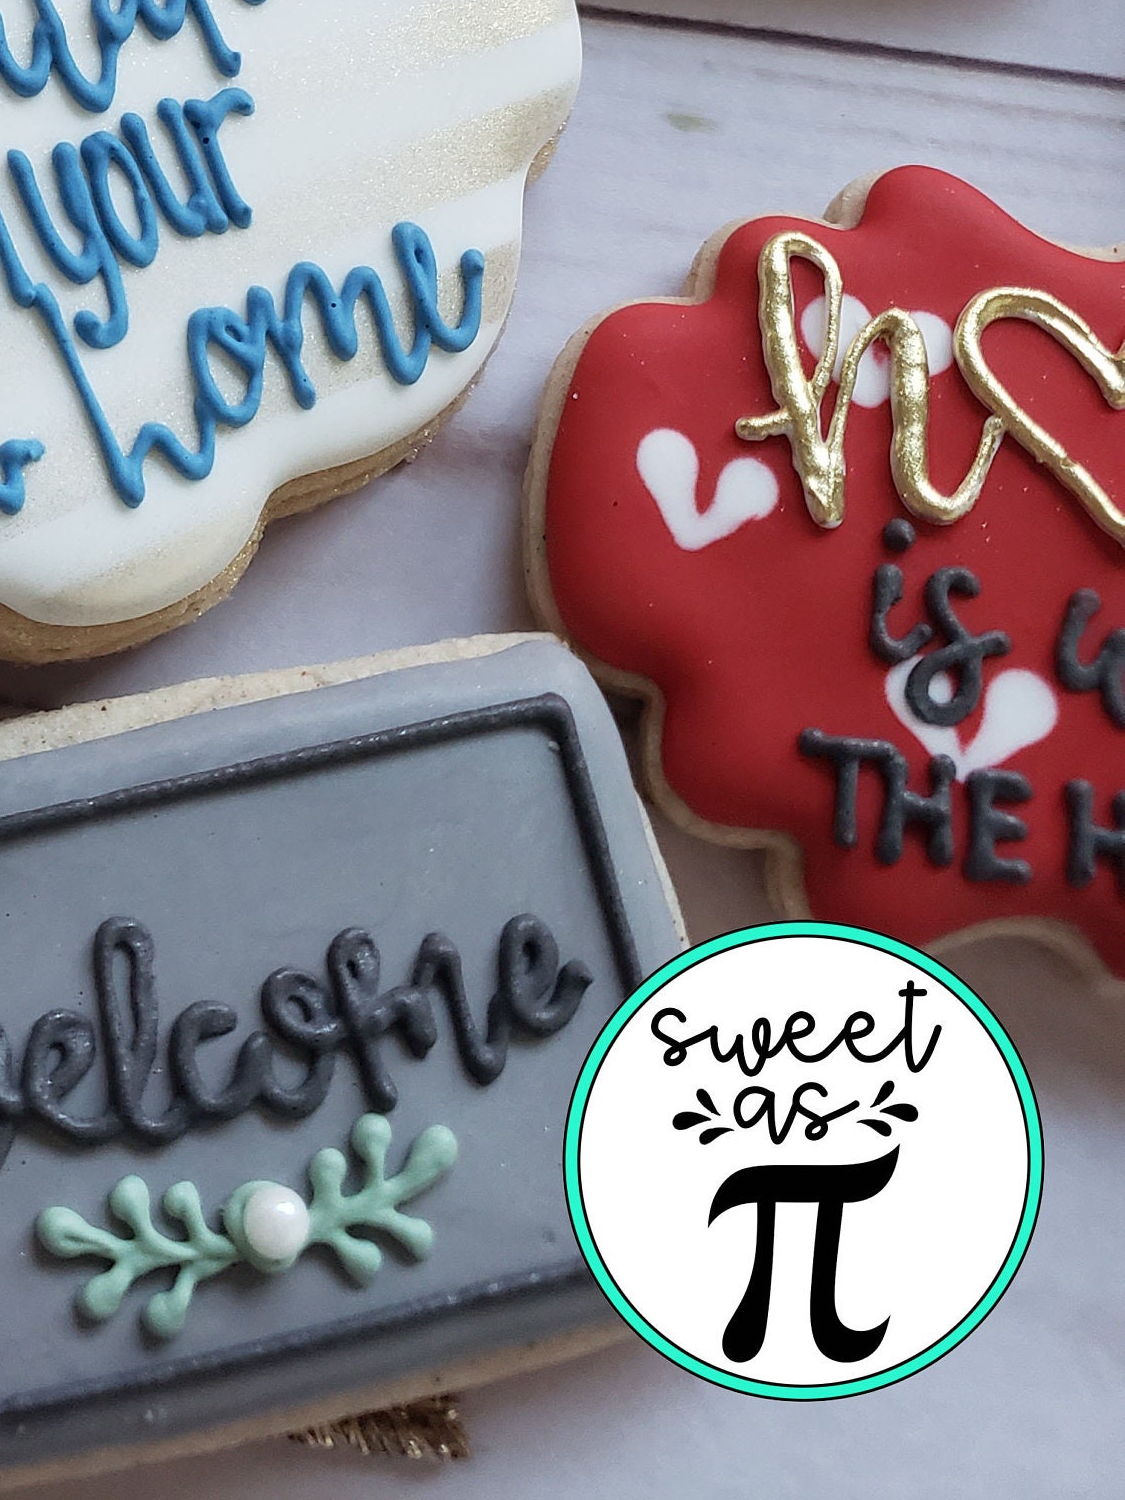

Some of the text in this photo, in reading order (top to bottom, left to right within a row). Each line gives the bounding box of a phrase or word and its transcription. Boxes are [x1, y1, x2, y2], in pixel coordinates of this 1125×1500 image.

[32, 221, 485, 509] home
[869, 518, 1013, 728] is
[798, 726, 1034, 884] THE
